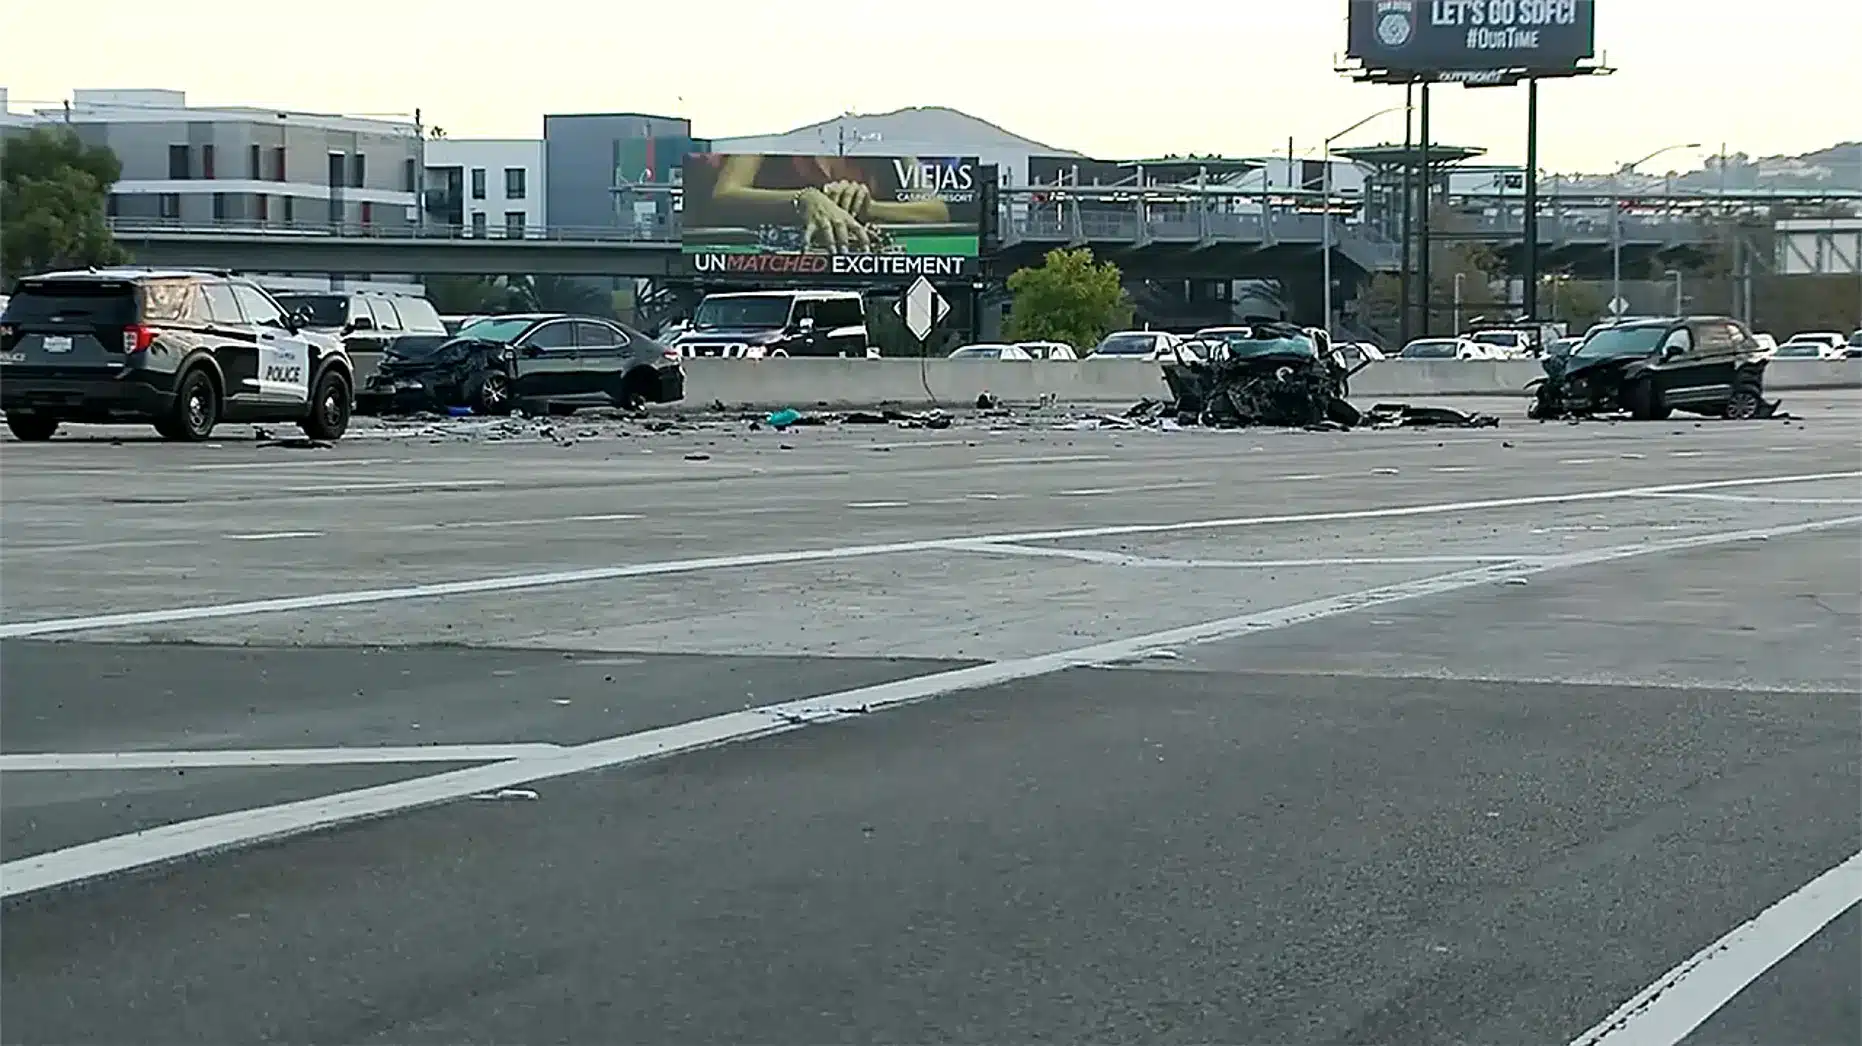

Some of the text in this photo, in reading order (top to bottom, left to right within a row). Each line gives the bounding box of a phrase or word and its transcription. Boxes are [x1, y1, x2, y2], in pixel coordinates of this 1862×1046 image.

[1431, 0, 1576, 25] LET'S GO SDFC!
[893, 159, 973, 196] VIEJAS
[694, 254, 965, 274] UNMATCHED EXCITEMENT
[265, 365, 301, 383] POLICE
